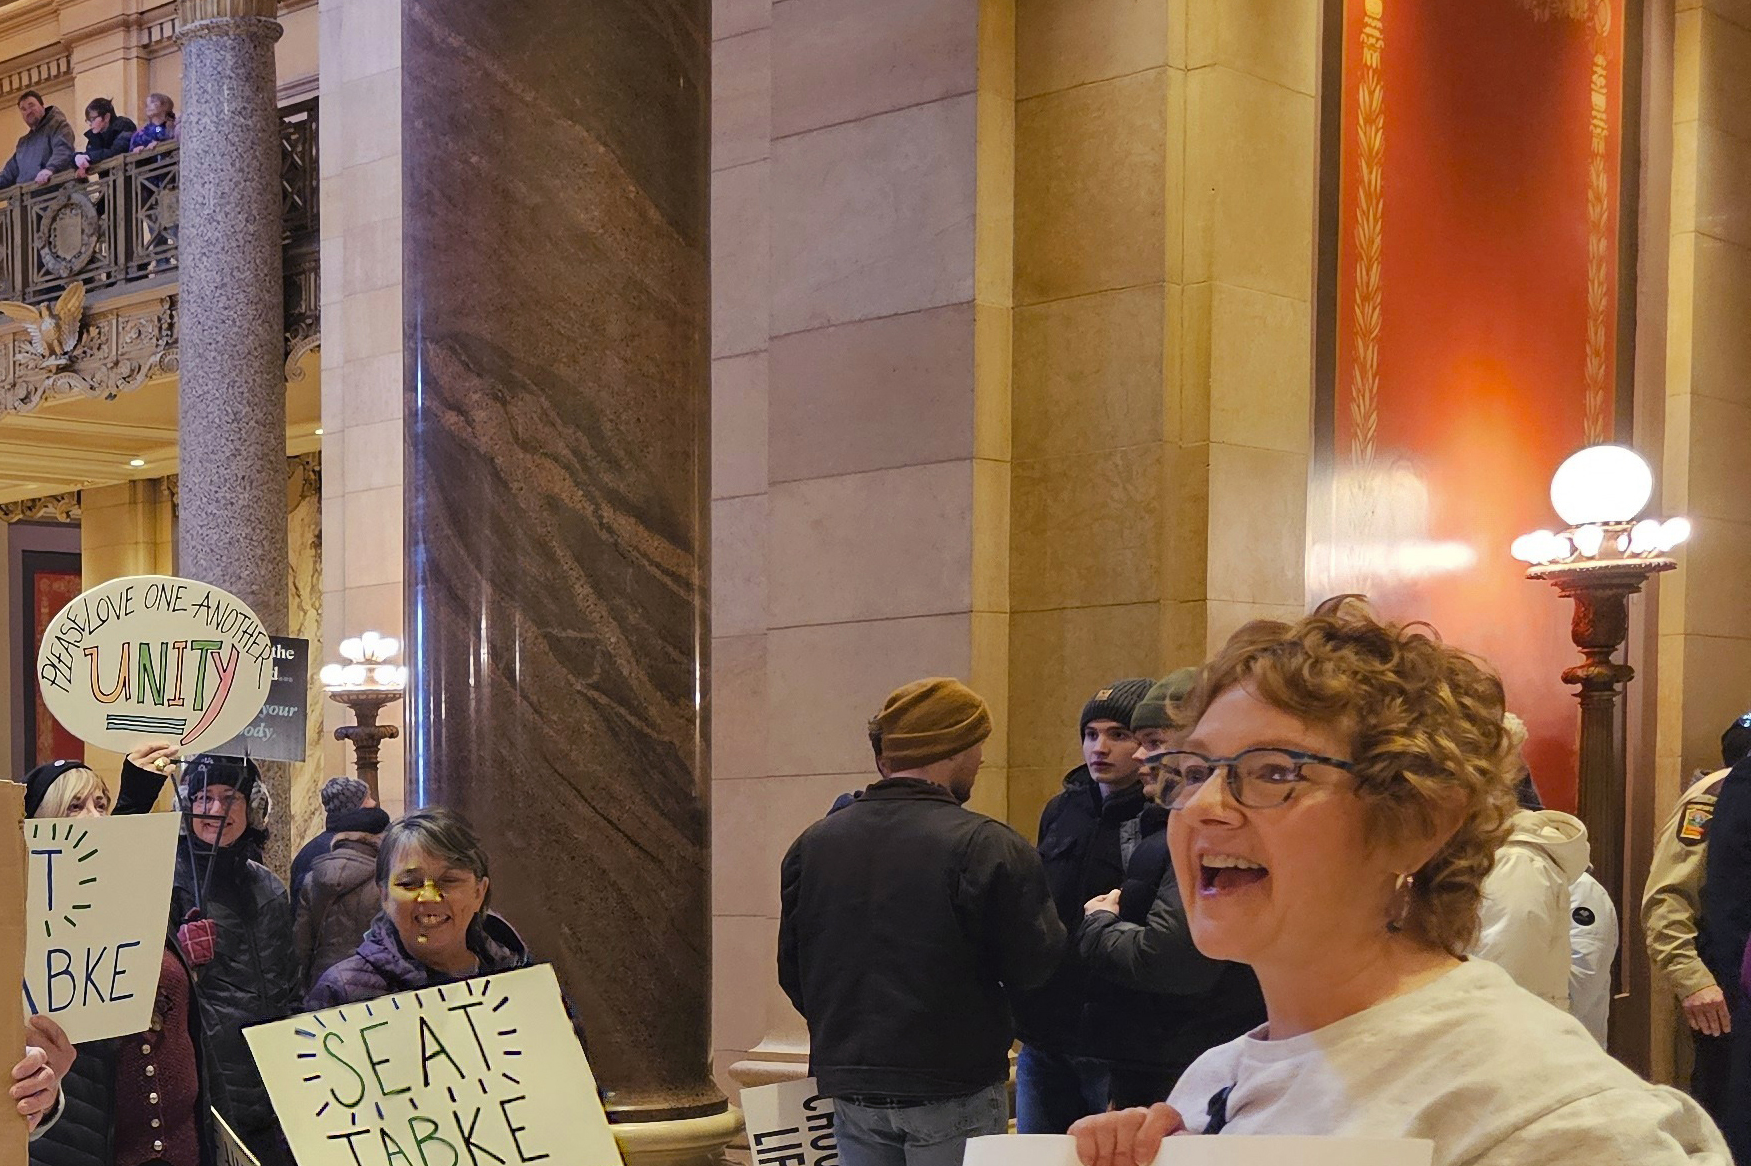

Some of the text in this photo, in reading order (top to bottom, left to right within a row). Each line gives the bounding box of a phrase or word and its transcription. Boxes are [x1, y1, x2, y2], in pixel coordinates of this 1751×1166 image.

[41, 583, 273, 693] PLEASE LOVE ONE ANOTHER
[83, 639, 240, 747] UNITY
[323, 1002, 491, 1108] SEAT
